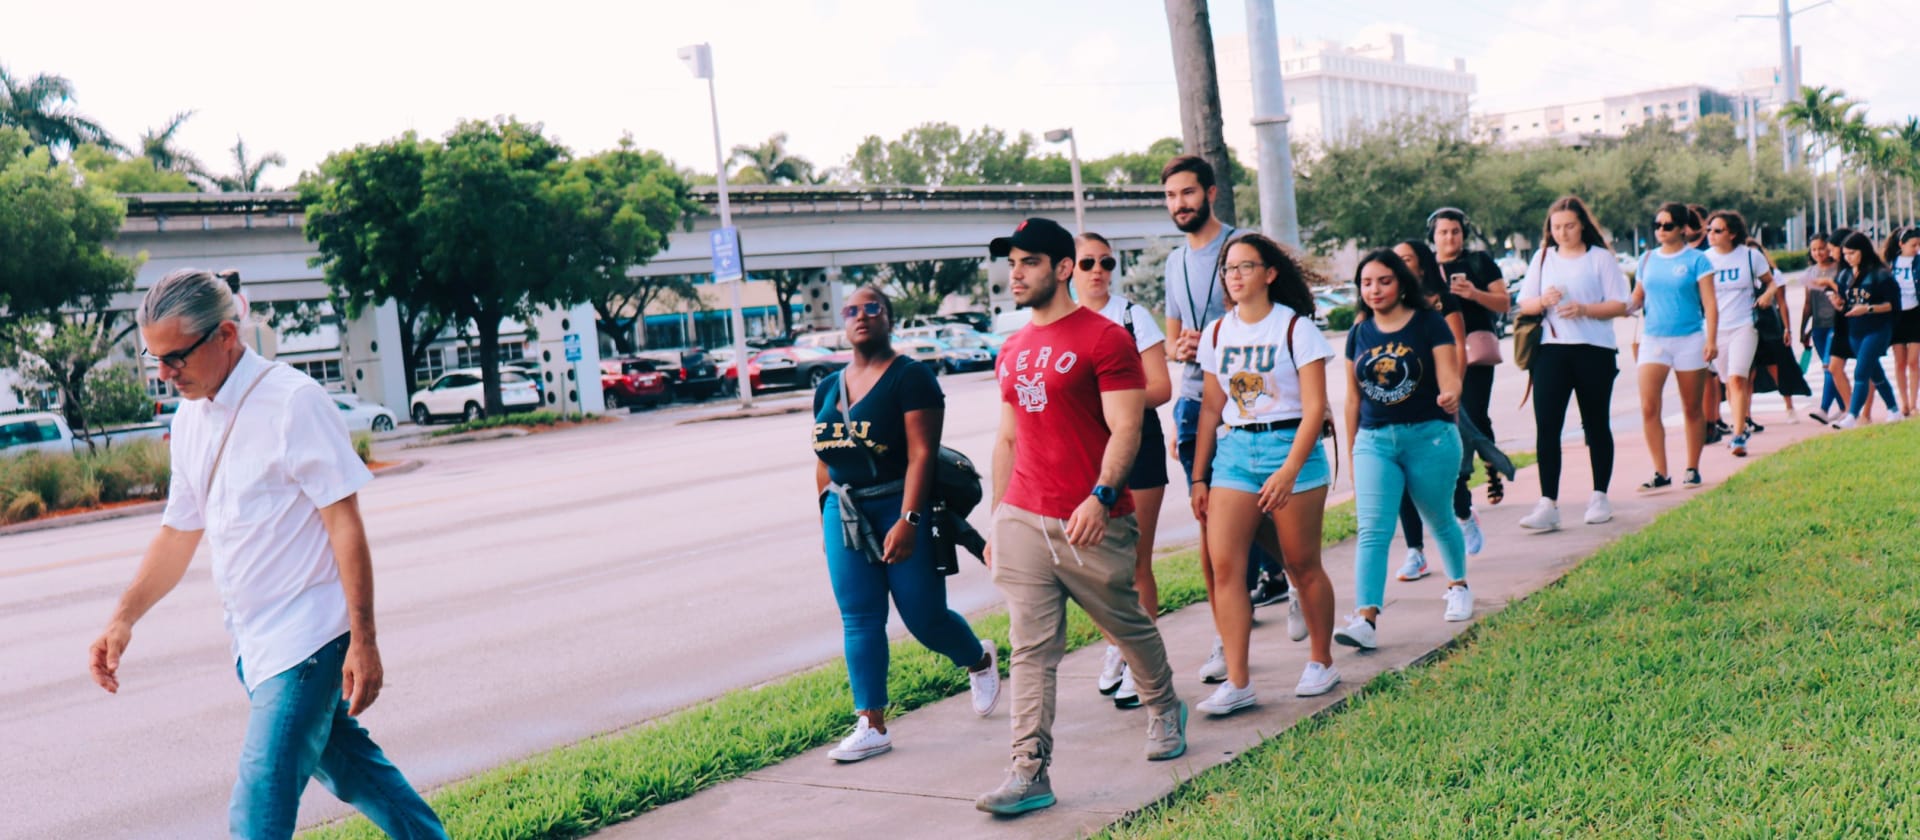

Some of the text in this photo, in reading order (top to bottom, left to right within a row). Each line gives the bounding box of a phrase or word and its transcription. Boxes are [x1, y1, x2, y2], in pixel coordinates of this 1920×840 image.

[1715, 268, 1740, 282] IU
[1370, 341, 1411, 357] FIU
[1220, 344, 1279, 375] FIU
[813, 421, 872, 442] FIU
